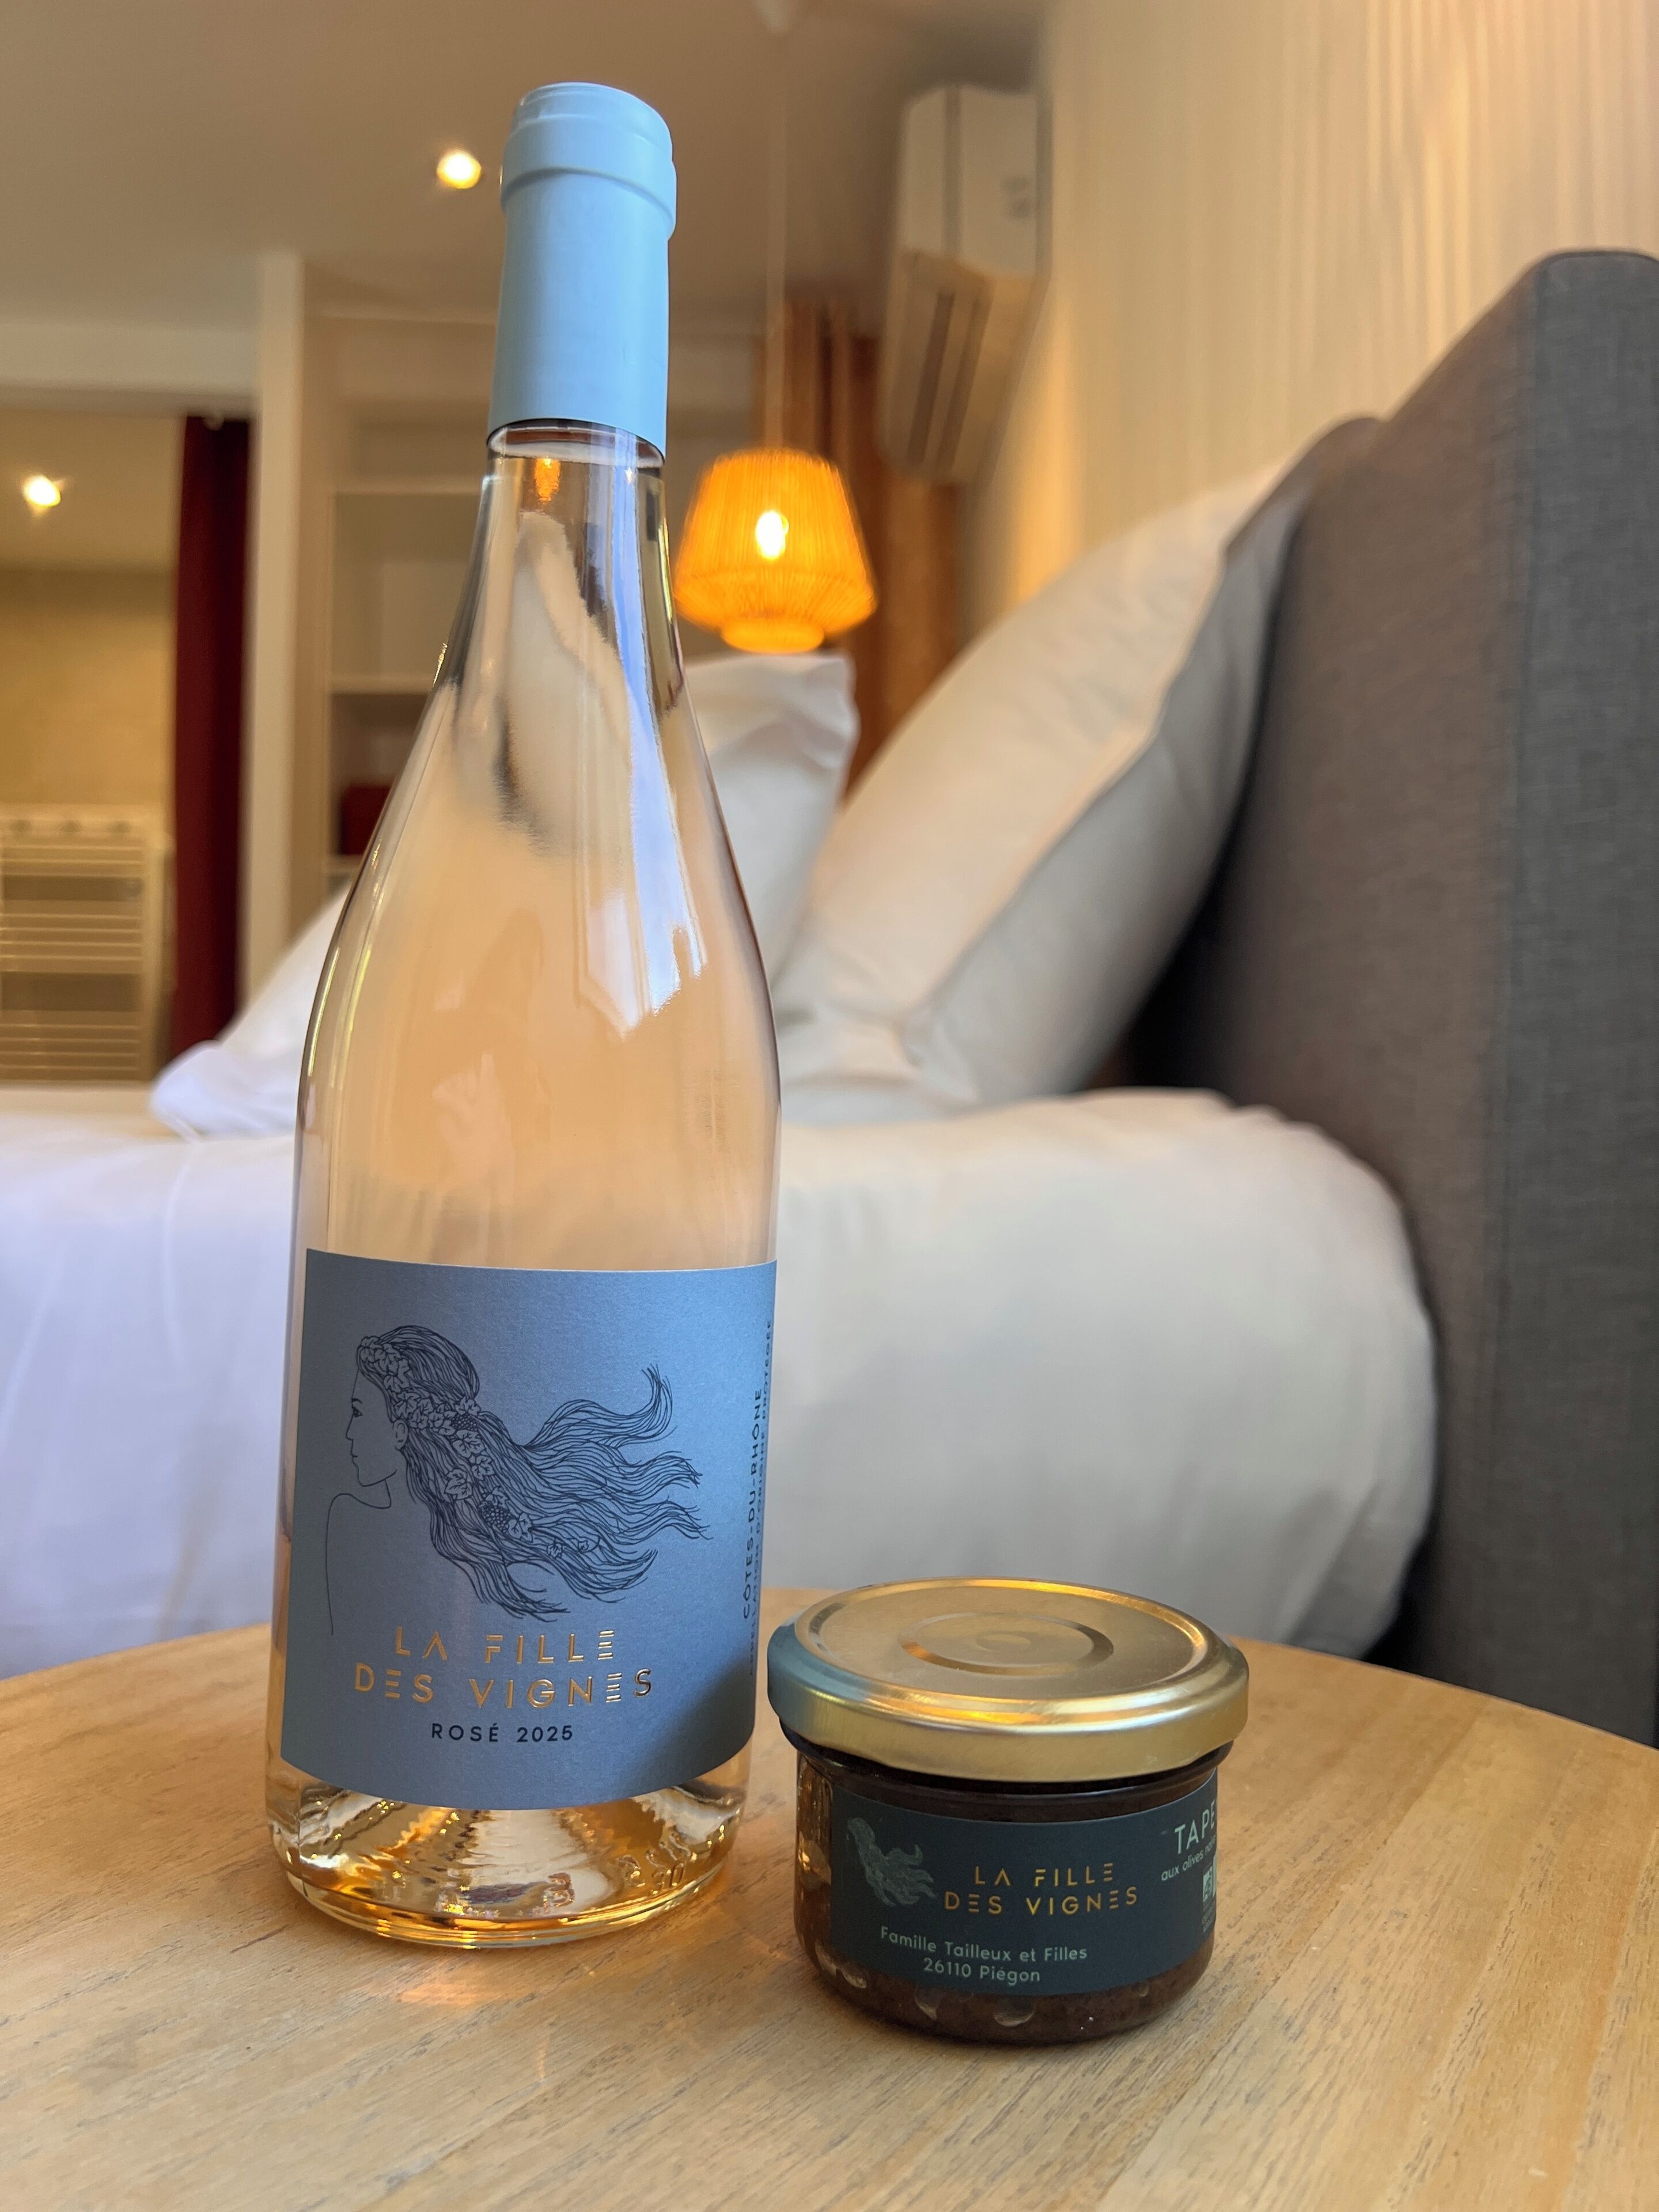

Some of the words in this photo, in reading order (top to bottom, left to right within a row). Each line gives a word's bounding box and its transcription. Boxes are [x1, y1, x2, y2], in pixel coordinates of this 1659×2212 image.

[743, 1389, 762, 1619] CÔTES-DU-RHÔNE
[395, 1626, 449, 1661] LA
[484, 1629, 615, 1664] FILLE
[355, 1662, 434, 1703] DES
[469, 1668, 652, 1709] VIGNES
[431, 1722, 499, 1742] ROSÉ
[517, 1725, 573, 1743] 2025
[974, 1866, 1011, 1886] LA
[1035, 1862, 1113, 1887] FILLE
[1161, 1865, 1180, 1881] aux
[1183, 1850, 1204, 1871] olives
[945, 1891, 1002, 1915] DES
[1026, 1886, 1138, 1915] VIGNES
[881, 1926, 937, 1952] Famille
[944, 1941, 1012, 1961] Tailleux
[1019, 1948, 1036, 1962] et
[1044, 1946, 1088, 1961] Filles
[923, 1957, 972, 1978] 26110
[980, 1965, 1040, 1986] Piégon
